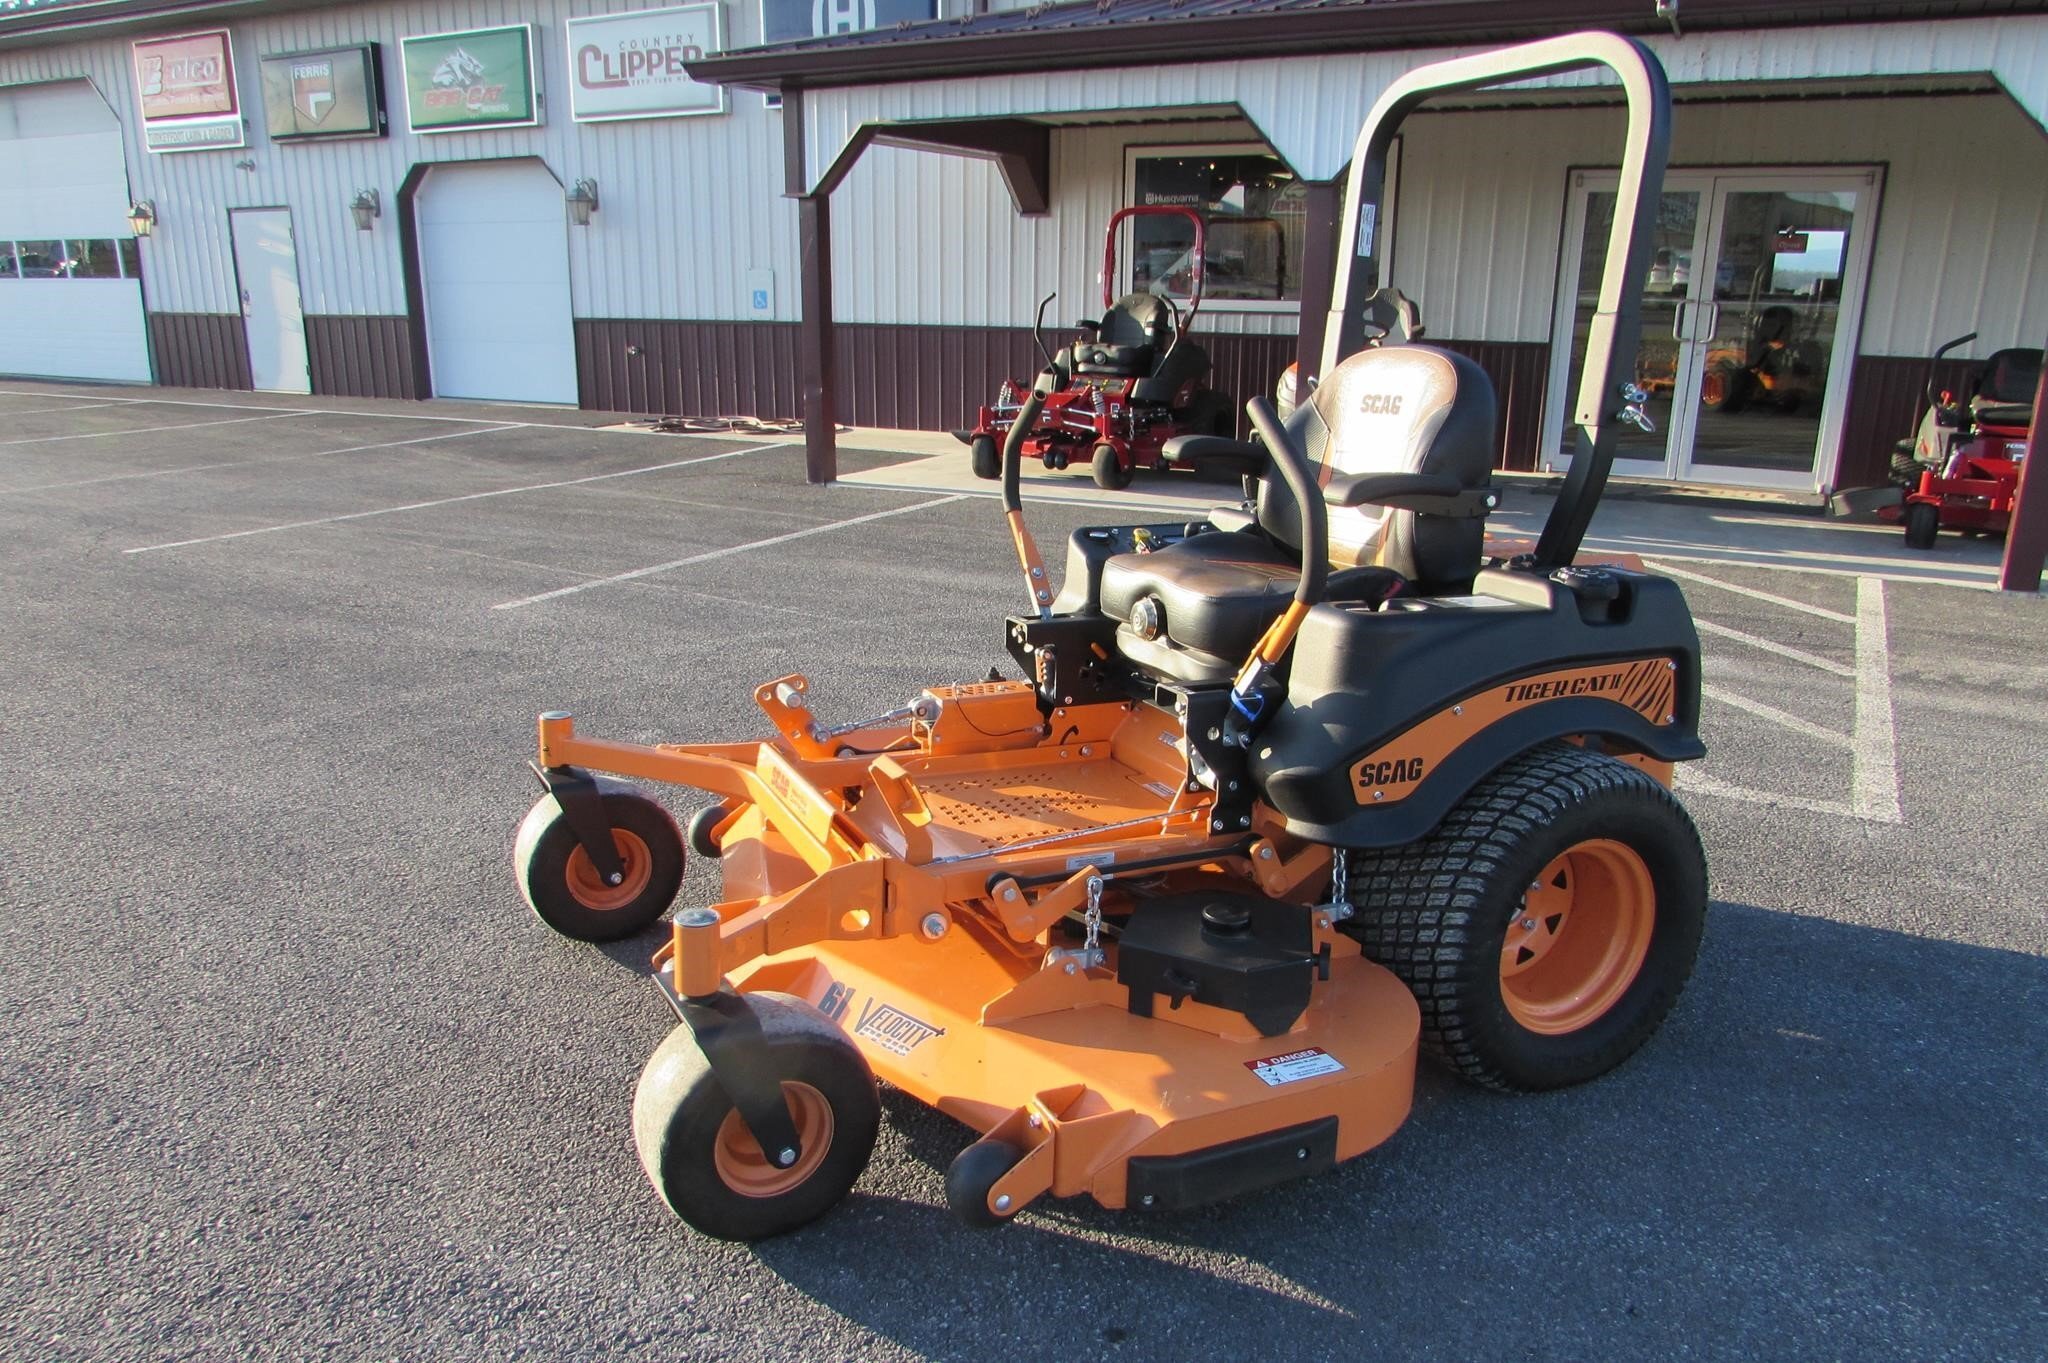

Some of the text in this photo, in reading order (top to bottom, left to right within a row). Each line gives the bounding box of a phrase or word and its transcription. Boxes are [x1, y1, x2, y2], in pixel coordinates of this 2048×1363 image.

[619, 34, 694, 50] COUNTRY
[294, 63, 330, 79] FERRIS
[1360, 394, 1403, 416] SCAG
[1505, 679, 1569, 702] TIGER
[1570, 674, 1611, 695] CAT
[1359, 757, 1423, 787] SCAG
[818, 981, 856, 1021] 61
[855, 997, 937, 1048] VELOCITY
[1269, 1049, 1318, 1065] DANGER
